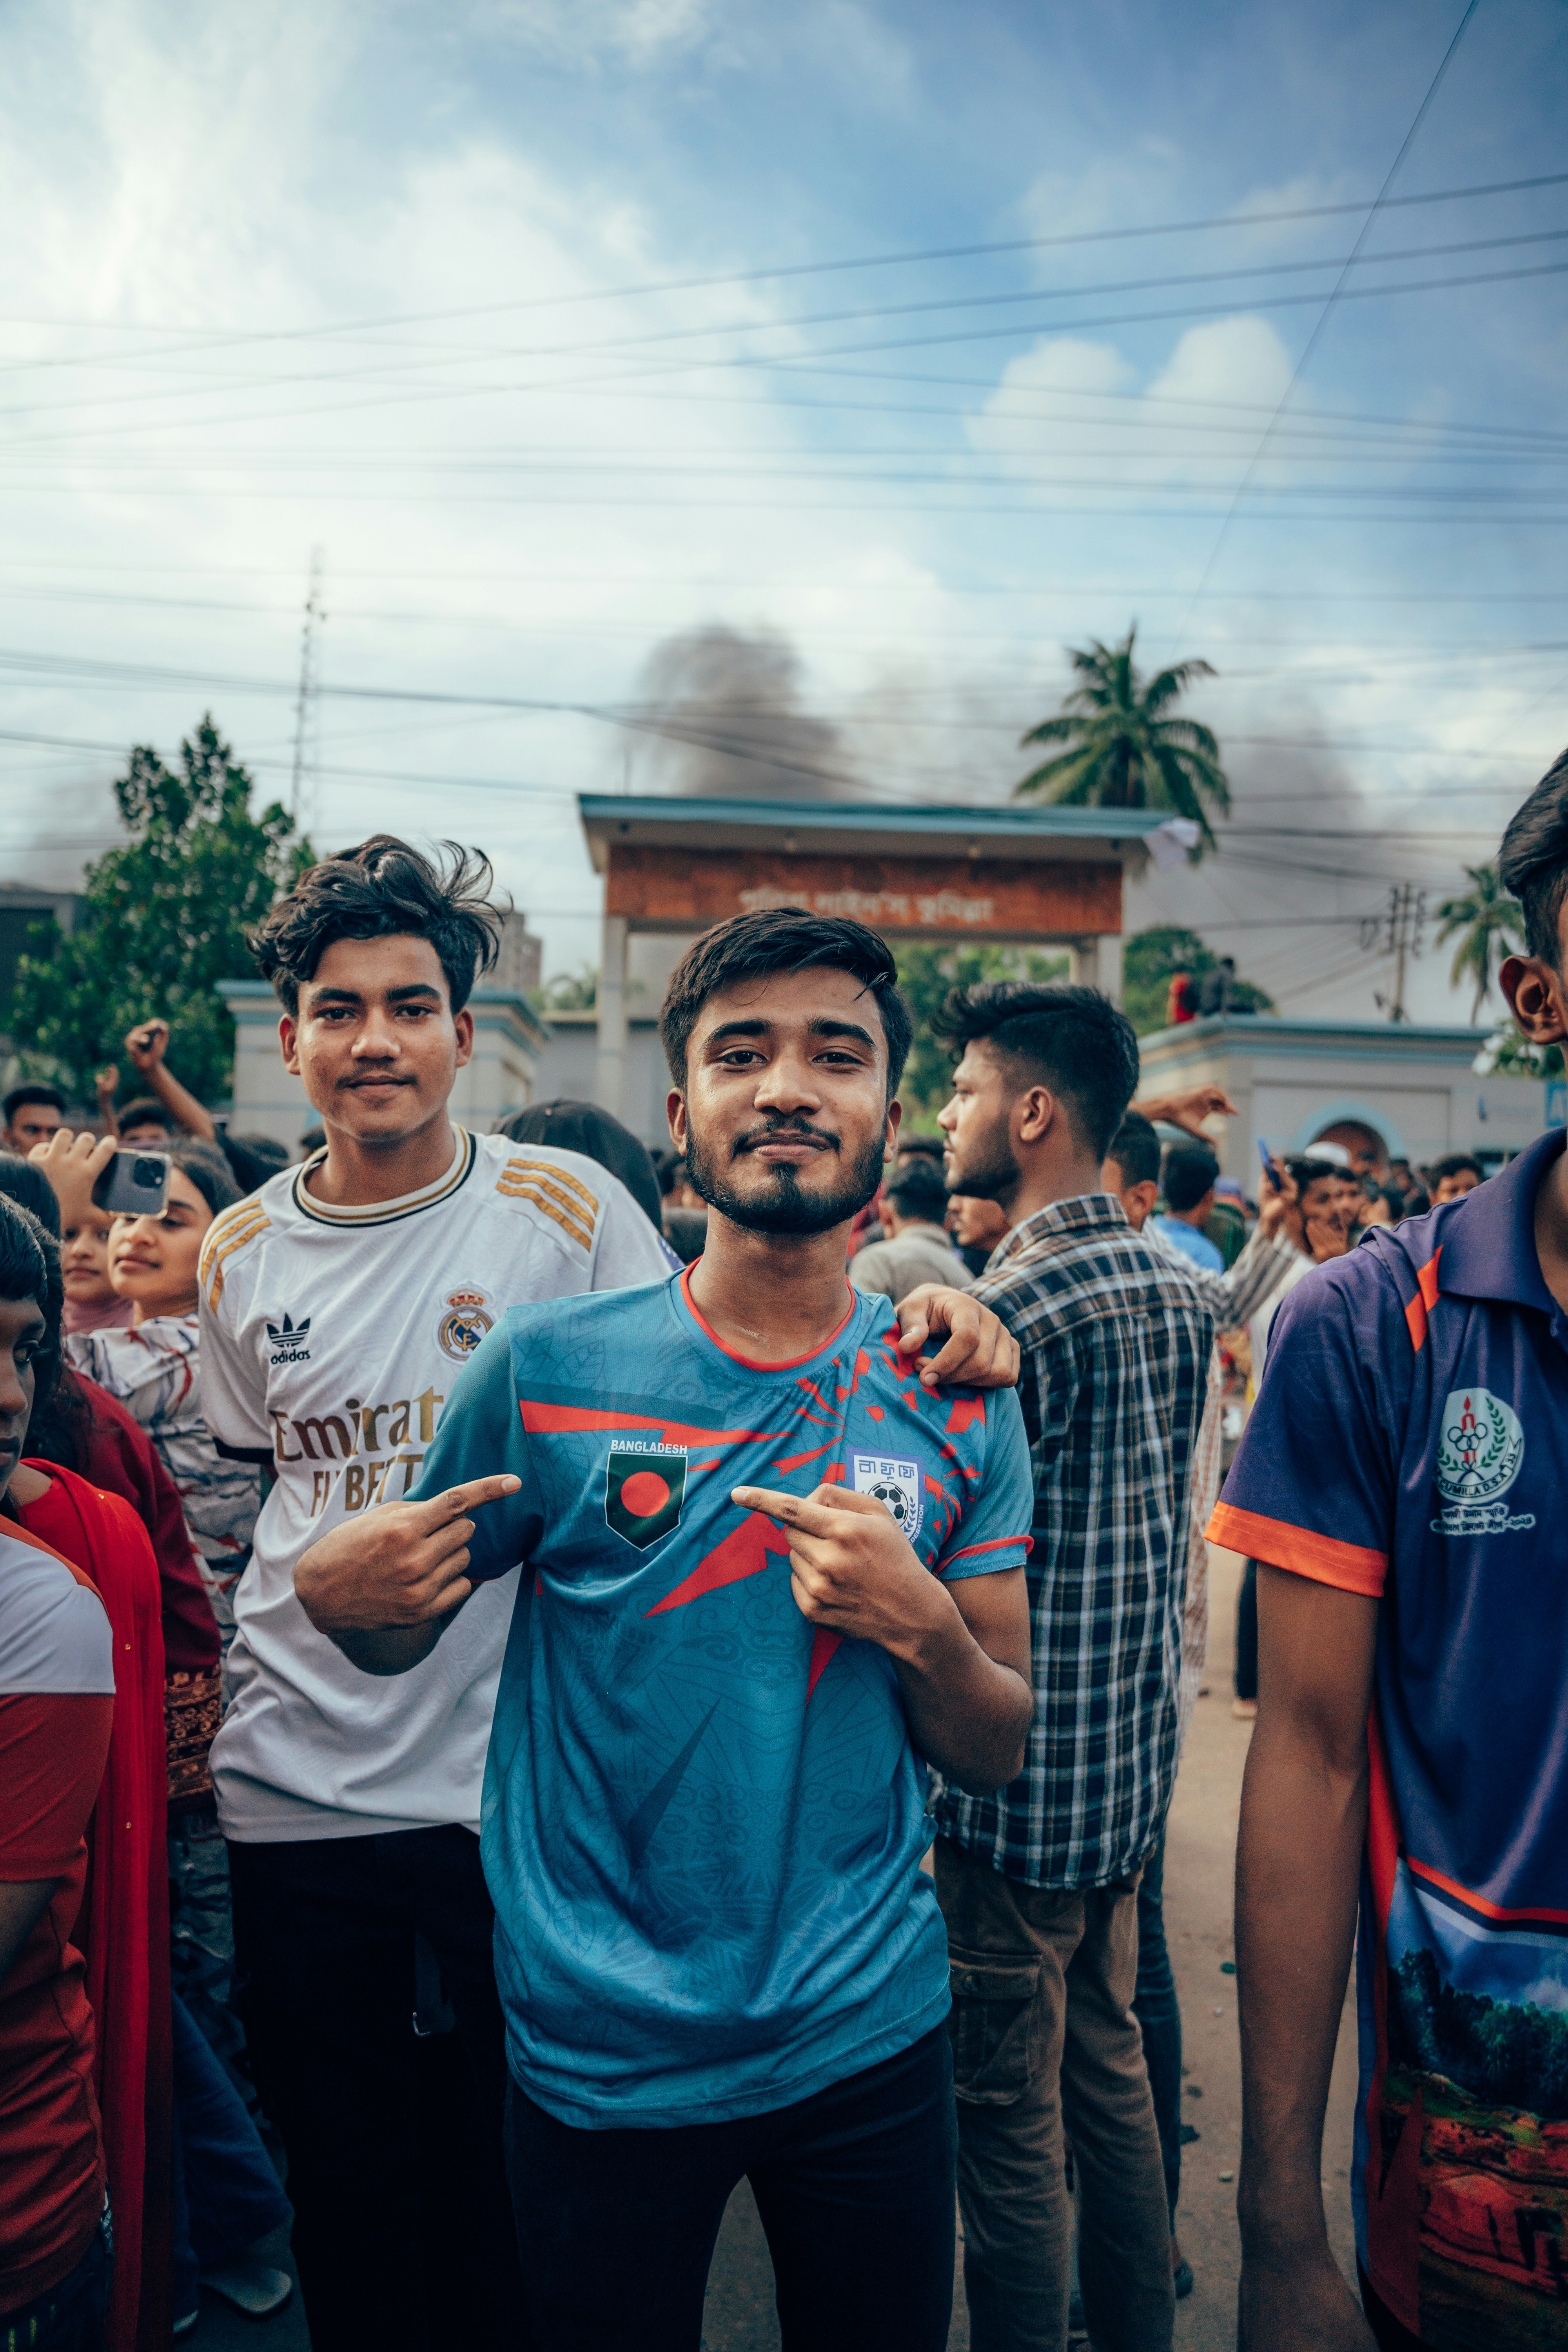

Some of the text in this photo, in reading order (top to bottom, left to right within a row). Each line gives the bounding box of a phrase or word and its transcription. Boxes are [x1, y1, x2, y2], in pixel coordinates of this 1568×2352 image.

[270, 1349, 310, 1365] adidas
[268, 1386, 444, 1462] Emirat
[611, 1439, 687, 1454] BANGLADESH
[909, 1504, 924, 1544] DERATION
